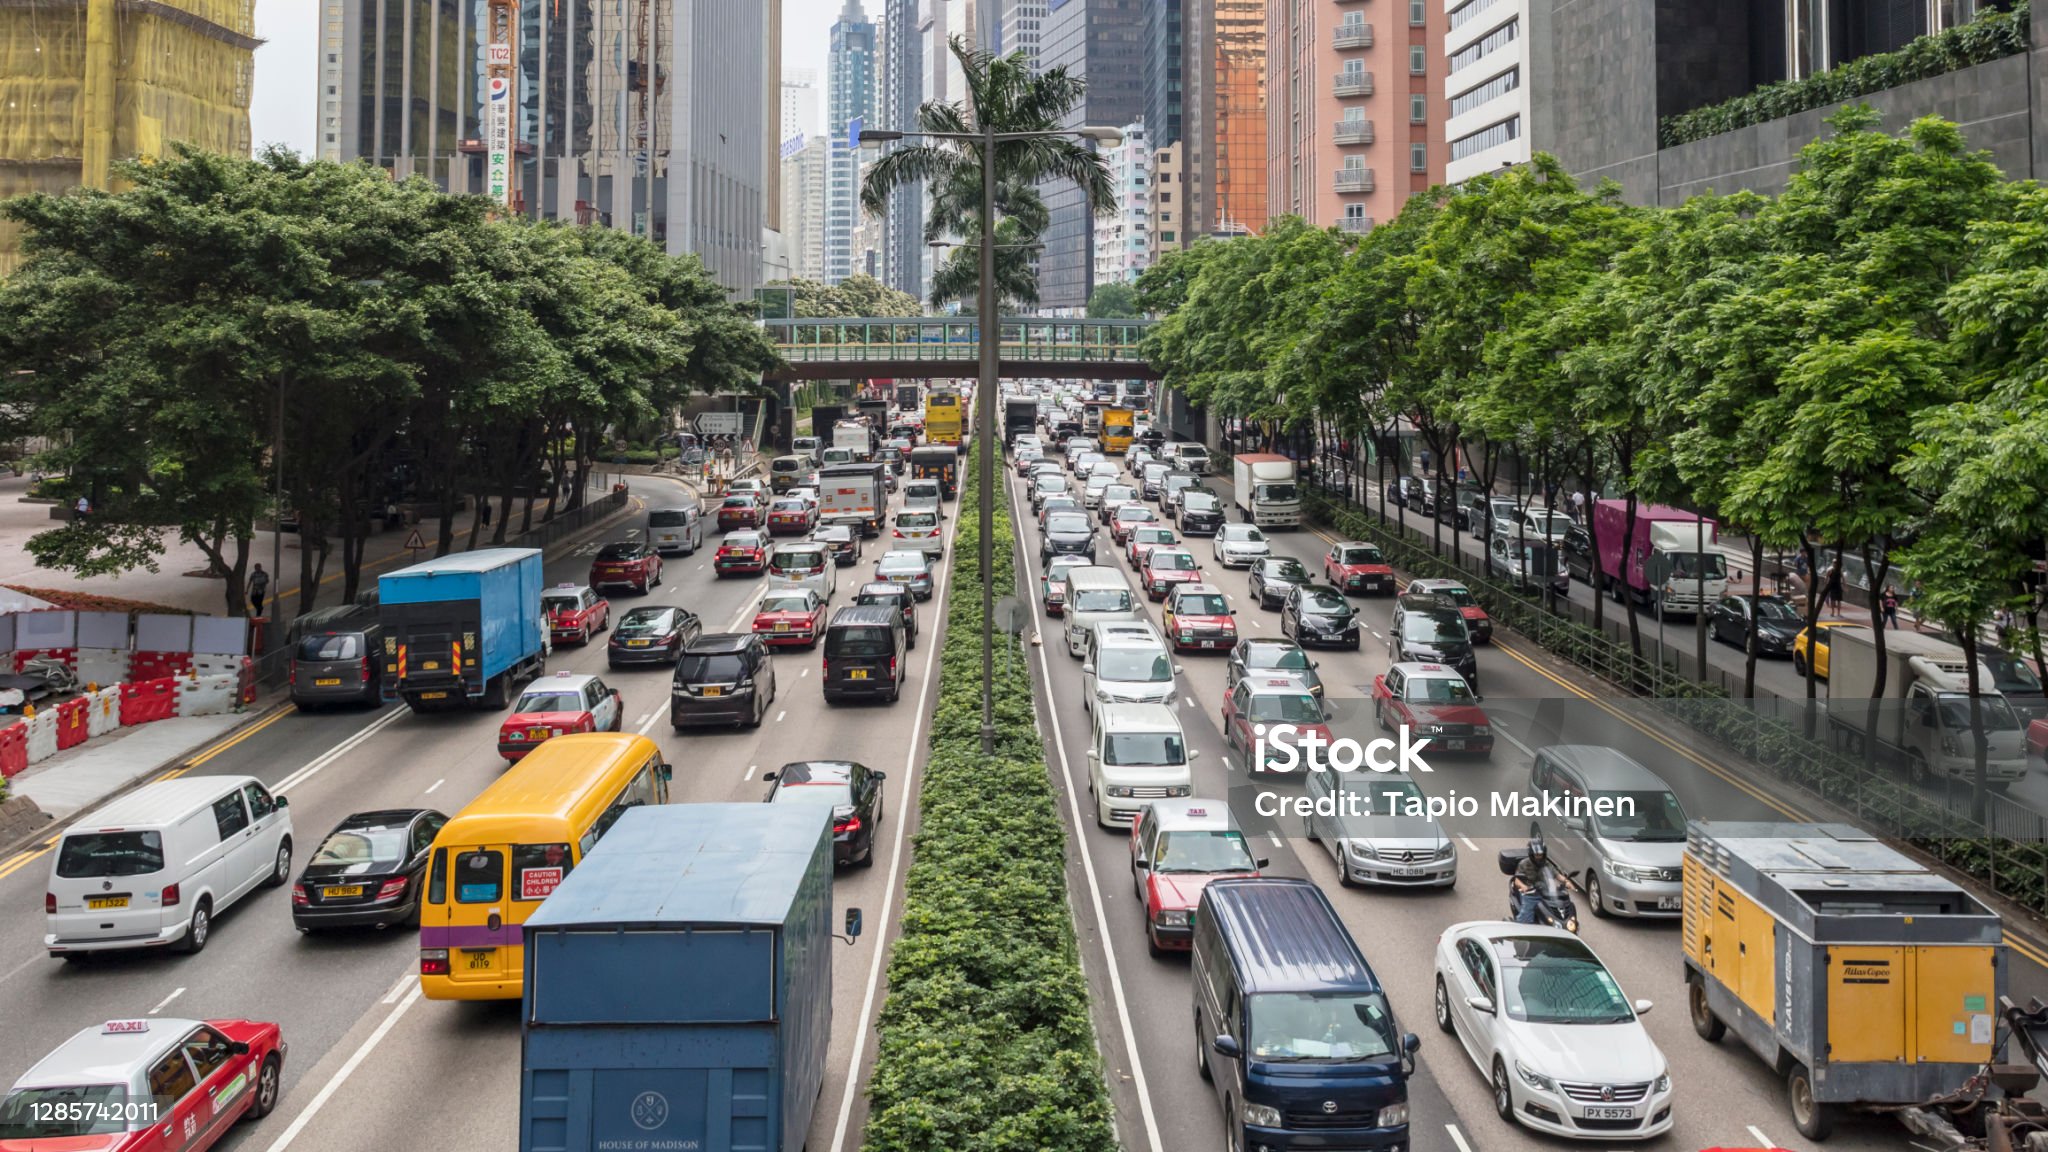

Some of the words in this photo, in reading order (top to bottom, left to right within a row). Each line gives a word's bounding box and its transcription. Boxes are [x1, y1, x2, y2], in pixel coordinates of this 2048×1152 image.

[491, 48, 509, 60] TC2
[529, 871, 557, 879] CAUTION
[526, 878, 559, 886] CHILDREN
[328, 888, 340, 896] HU
[93, 900, 103, 908] TT
[470, 960, 490, 969] 8119
[1844, 967, 1866, 976] Atlas
[1867, 967, 1890, 978] Copco
[107, 1021, 142, 1031] TAXI
[1587, 1108, 1601, 1118] PX
[1604, 1108, 1632, 1118] 5573
[599, 1140, 633, 1150] HOUSE
[635, 1140, 649, 1150] OF
[651, 1140, 699, 1150] MADISON
